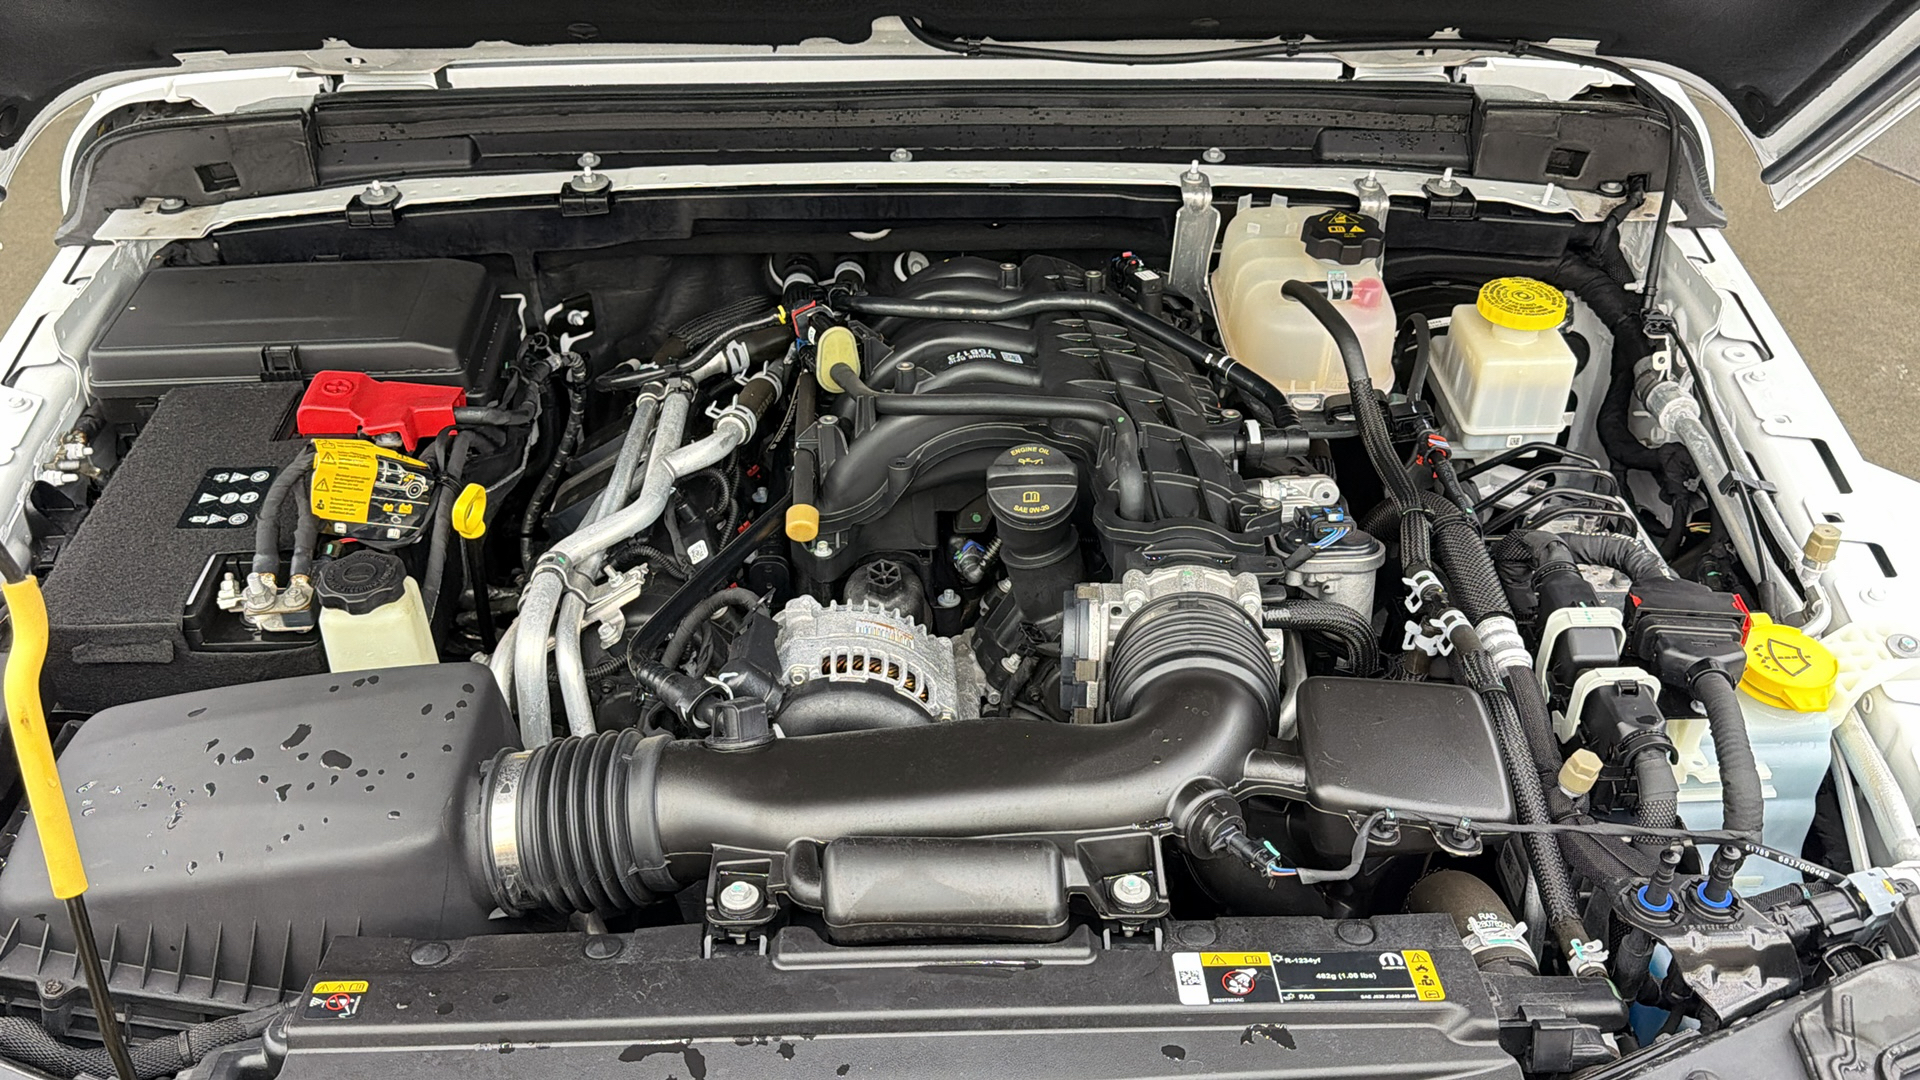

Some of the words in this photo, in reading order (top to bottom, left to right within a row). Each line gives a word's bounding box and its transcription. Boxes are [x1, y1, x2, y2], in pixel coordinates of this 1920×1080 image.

[1010, 446, 1037, 456] ENGINE
[1038, 447, 1050, 456] OIL
[1013, 504, 1028, 514] SAE
[1028, 504, 1050, 514] 0W-20
[1477, 912, 1498, 921] RAD
[1284, 957, 1321, 965] R-1234yf
[1360, 972, 1377, 981] lbs)
